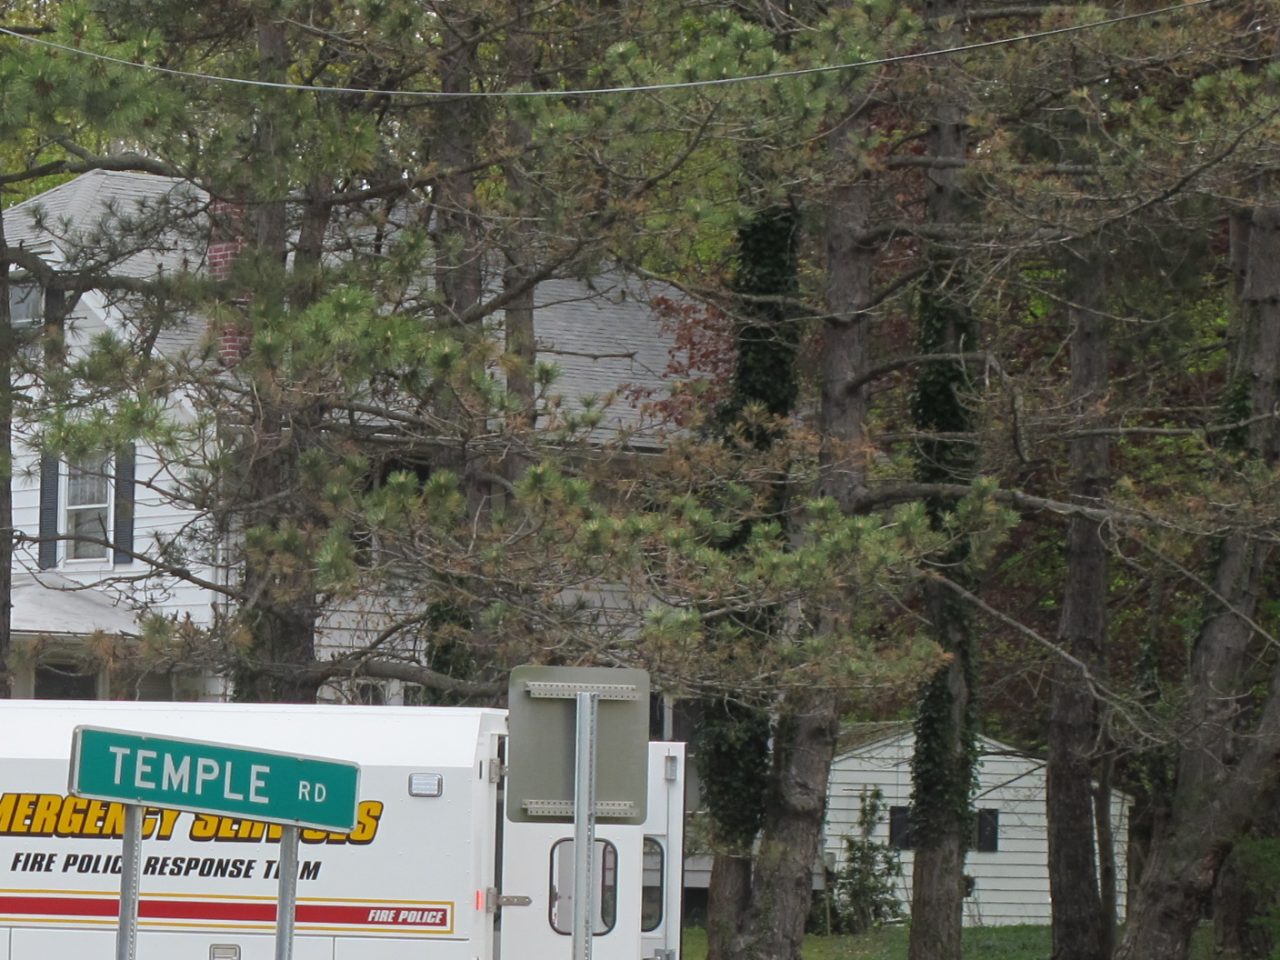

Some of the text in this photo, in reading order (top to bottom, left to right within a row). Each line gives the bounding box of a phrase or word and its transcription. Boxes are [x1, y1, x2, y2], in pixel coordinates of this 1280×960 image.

[109, 745, 327, 804] TEMPLE RD
[10, 852, 322, 881] FIRE POLIC RESPONSE TM
[368, 910, 444, 923] FIRE POLICE
